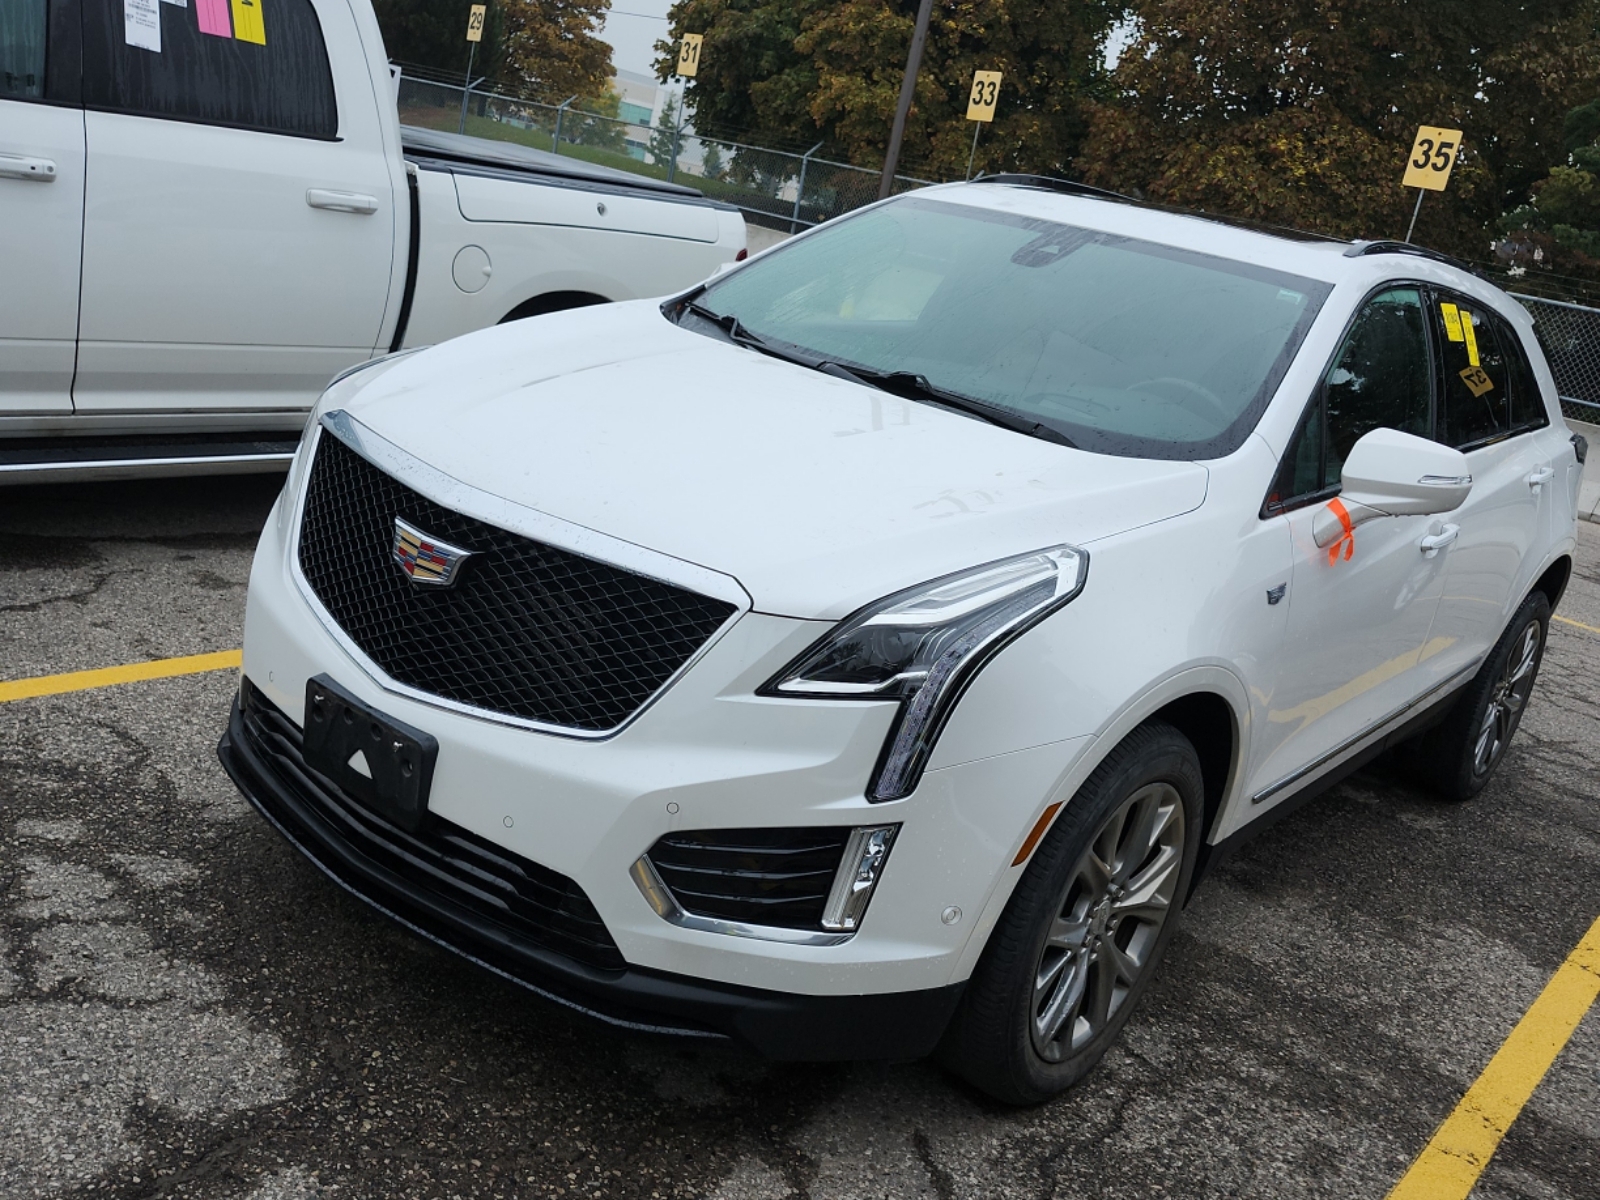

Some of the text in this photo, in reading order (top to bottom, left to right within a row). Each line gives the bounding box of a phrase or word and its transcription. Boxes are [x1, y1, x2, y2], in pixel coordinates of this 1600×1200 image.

[470, 12, 483, 30] 29
[681, 41, 698, 63] 31
[972, 81, 997, 106] 33
[1412, 139, 1455, 172] 35
